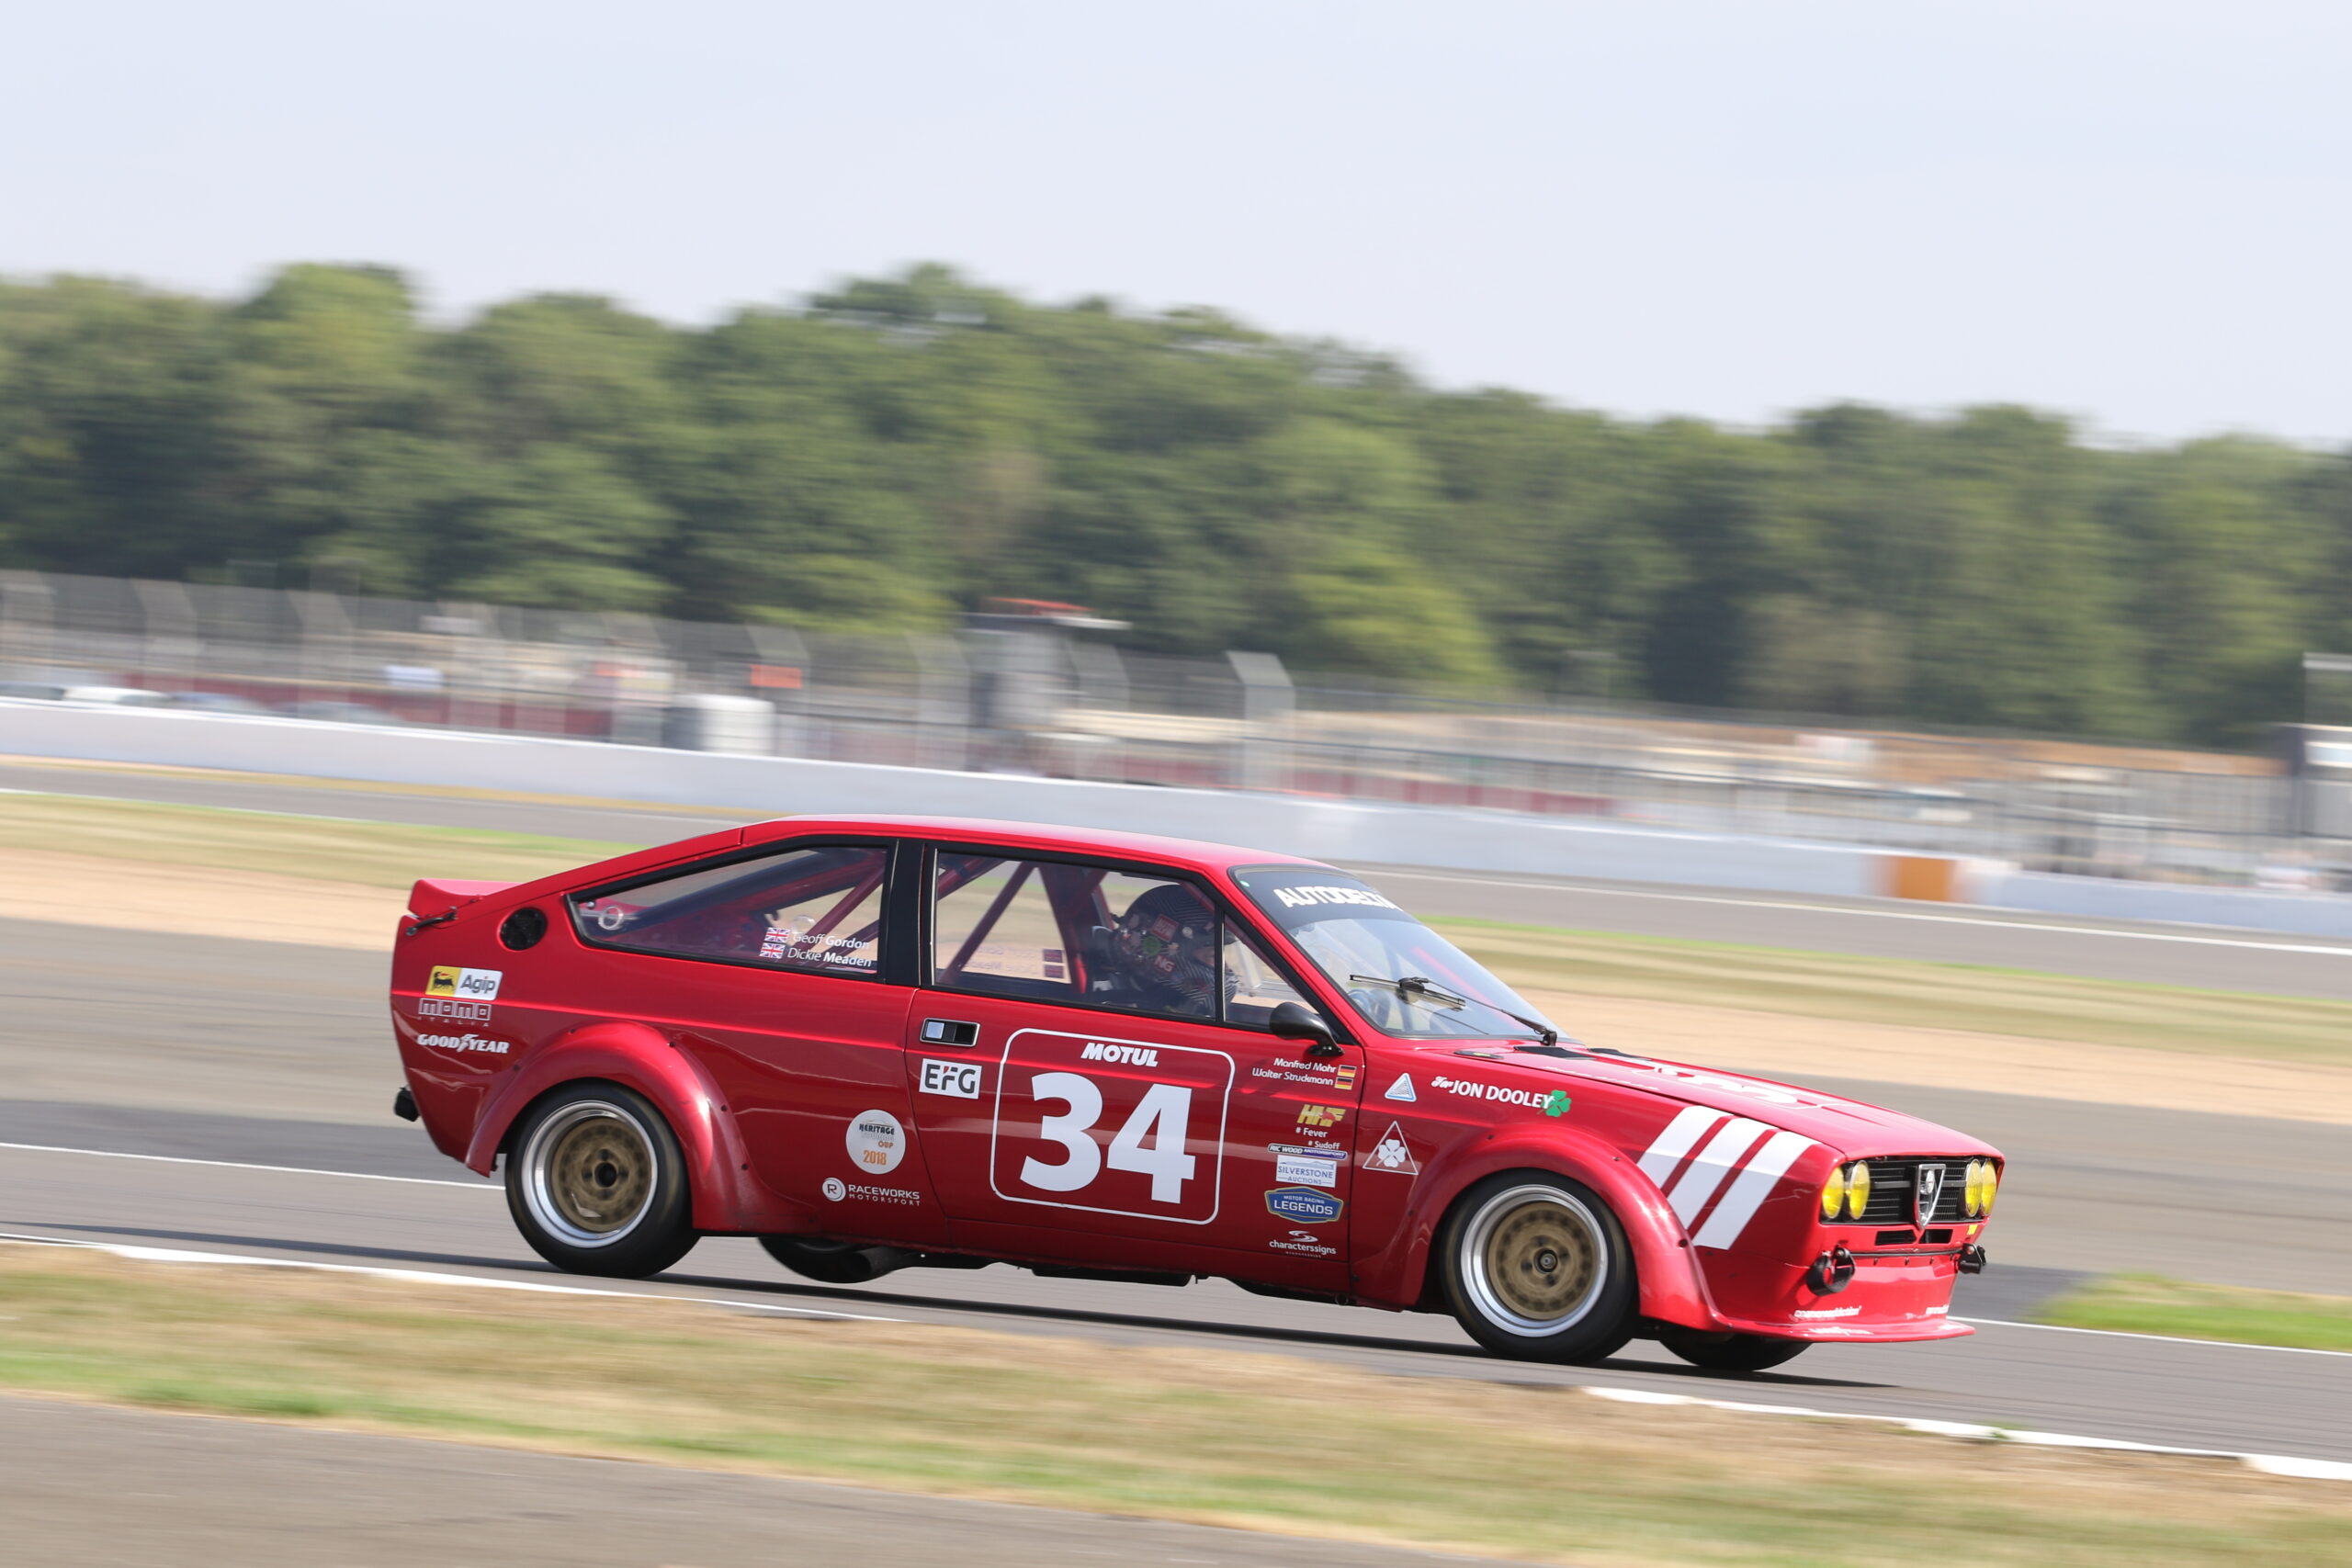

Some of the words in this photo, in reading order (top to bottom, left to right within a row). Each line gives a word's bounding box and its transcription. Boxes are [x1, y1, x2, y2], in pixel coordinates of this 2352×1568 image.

[793, 932, 825, 945] Geoff
[826, 935, 871, 950] Gordon
[787, 947, 822, 962] Dickie
[823, 952, 872, 967] Meaden
[460, 975, 496, 994] Agip
[417, 1033, 510, 1054] GOODYEAR
[1080, 1043, 1159, 1067] MOTUL
[1273, 1057, 1312, 1070] Manfred
[1313, 1063, 1337, 1073] Mohr
[924, 1065, 977, 1094] EFG
[1252, 1067, 1283, 1079] Walter
[1283, 1071, 1333, 1086] Struckmann
[1449, 1080, 1484, 1098] JON
[1486, 1086, 1556, 1109] DOOLEY
[859, 1123, 895, 1135] HERITAGE
[1303, 1127, 1328, 1138] Fever
[1020, 1072, 1196, 1204] 34
[1314, 1141, 1340, 1150] Sudoff
[863, 1149, 887, 1166] 2018
[1278, 1166, 1333, 1179] SILVERSTONE
[1287, 1176, 1322, 1185] AUCTIONS
[848, 1184, 921, 1200] RACEWORKS
[849, 1194, 921, 1206] MOTORSPORT
[1273, 1200, 1333, 1215] LEGENDS
[1269, 1240, 1337, 1255] characterssigns
